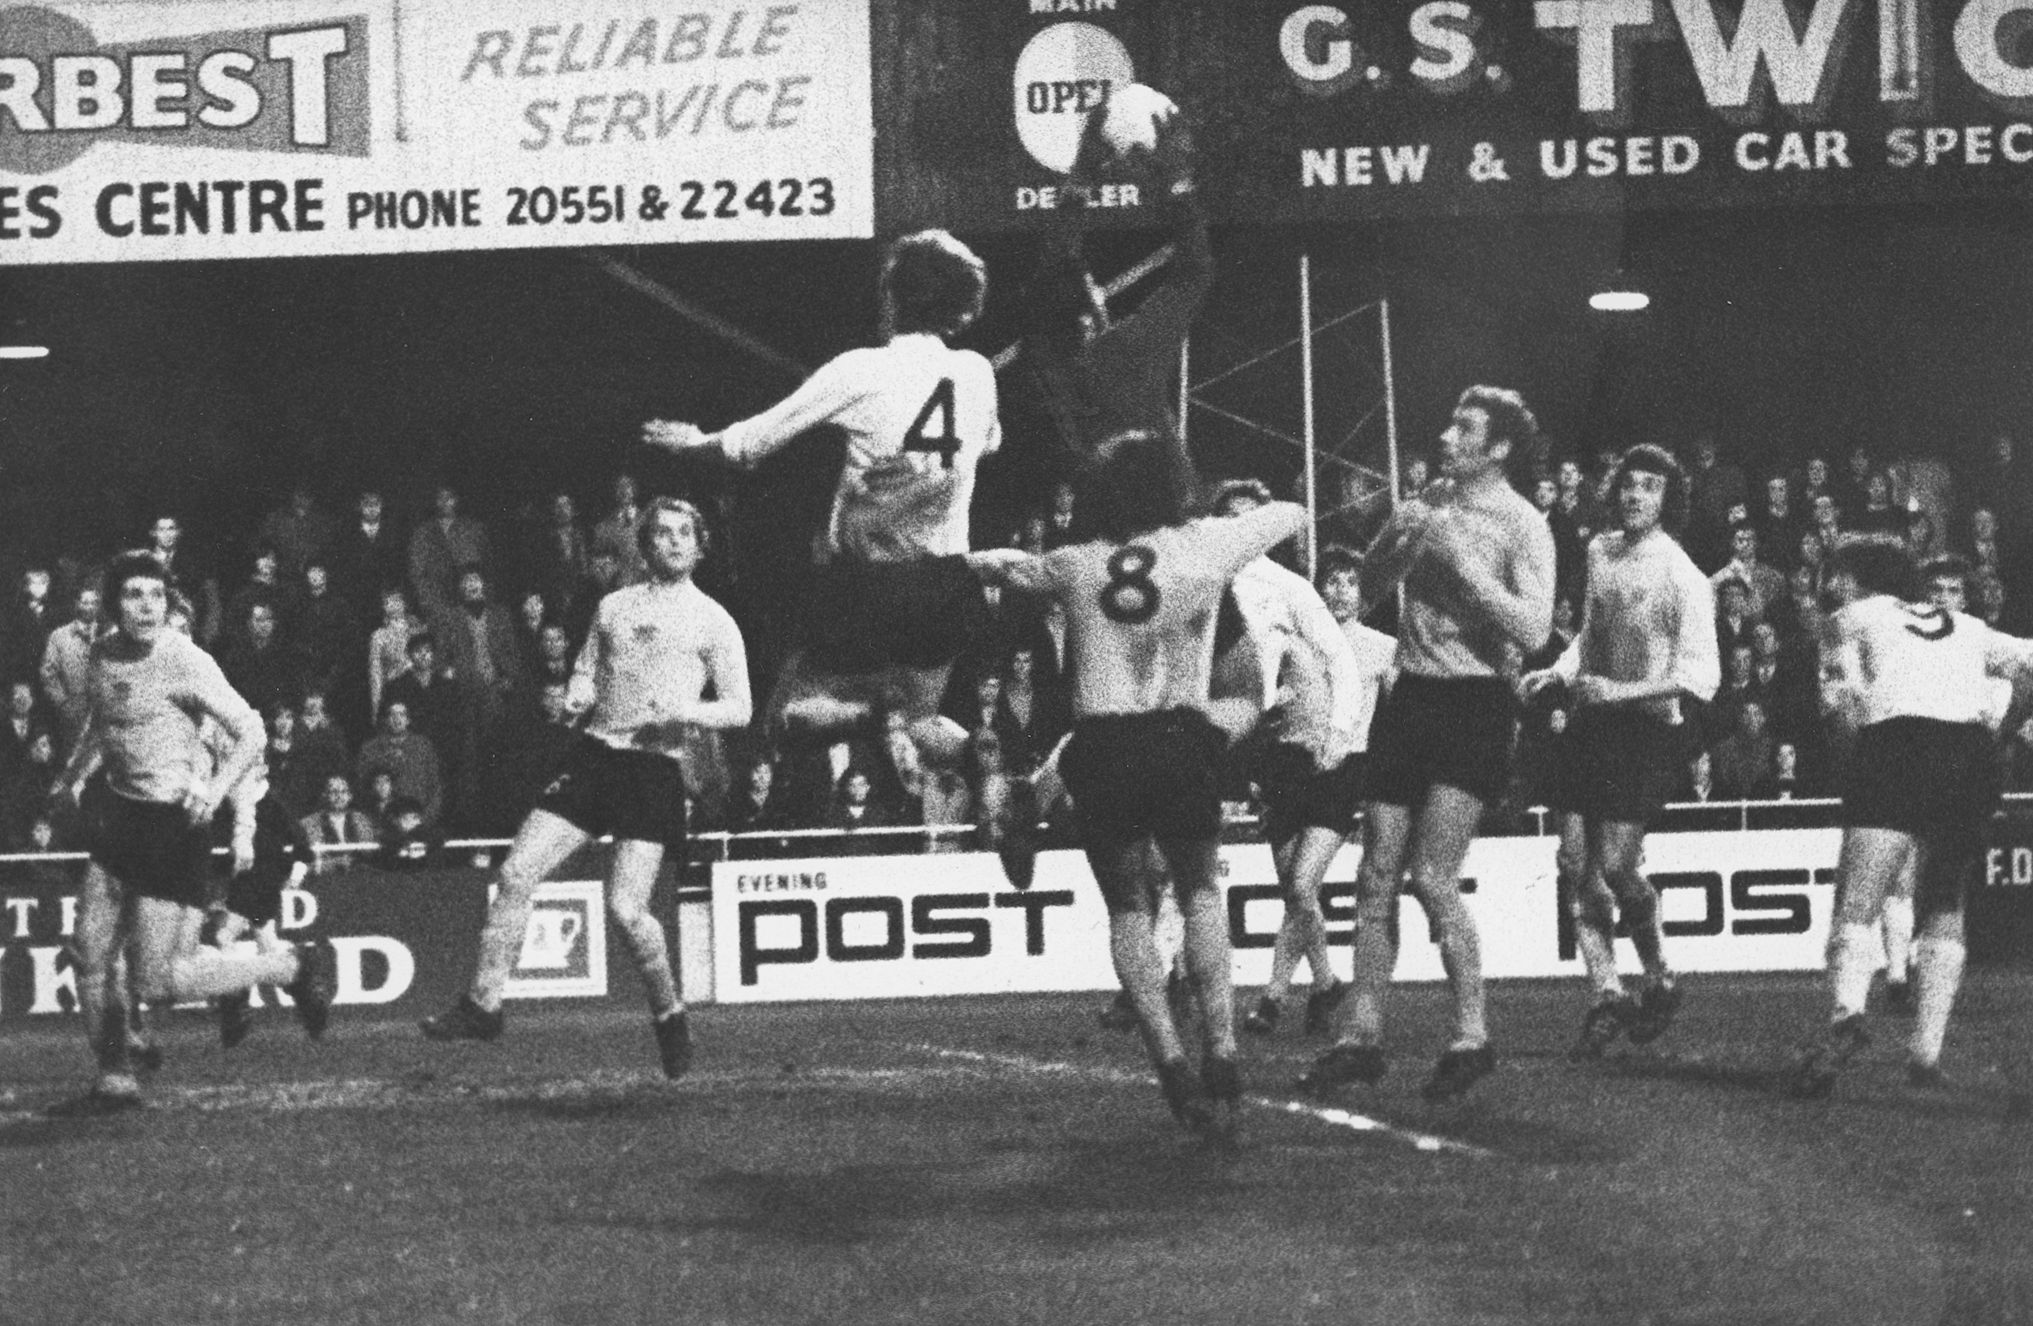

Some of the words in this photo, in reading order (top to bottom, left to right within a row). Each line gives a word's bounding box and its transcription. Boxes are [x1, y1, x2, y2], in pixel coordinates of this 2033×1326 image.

[459, 4, 802, 82] RELIABLE
[519, 75, 812, 152] SERVICE
[1301, 144, 1430, 187] NEW
[1468, 141, 1510, 182] &
[1540, 135, 1700, 179] USED
[1735, 129, 1851, 170] CAR
[1886, 123, 2033, 166] SPEC
[95, 178, 325, 238] CENTRE
[348, 188, 482, 230] PHONE
[507, 184, 625, 226] 20551
[638, 185, 669, 220] &
[680, 177, 836, 219] 22423
[904, 377, 962, 468] 4
[1101, 545, 1160, 625] 8
[738, 872, 827, 893] EVENING
[738, 890, 1075, 986] POST
